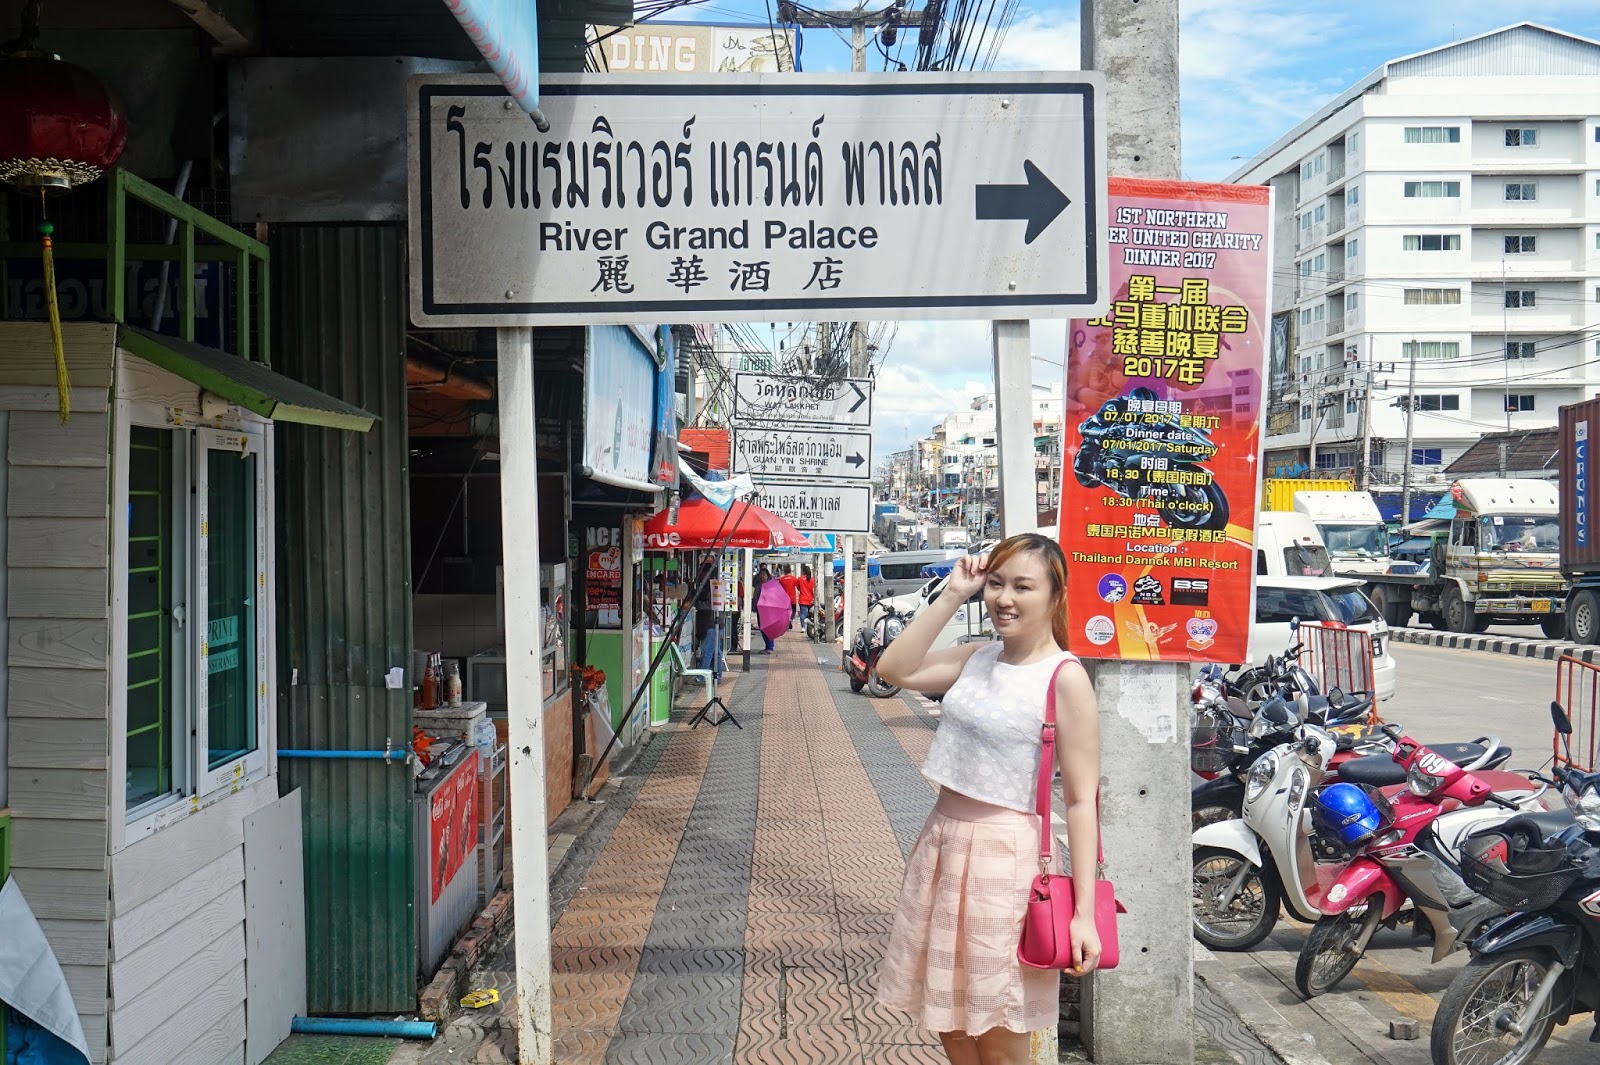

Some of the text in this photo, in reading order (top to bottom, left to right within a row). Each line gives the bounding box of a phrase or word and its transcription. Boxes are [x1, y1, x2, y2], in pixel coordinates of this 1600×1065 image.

[446, 107, 943, 210] โรงแรมริเวอร์ แกรนด์ พาเลส
[1116, 206, 1228, 229] 1ST NORTHERN
[539, 219, 878, 251] River Grand Palace
[1132, 228, 1189, 248] UNITED
[1192, 232, 1263, 251] CHARITY
[1124, 248, 1217, 269] DINNER 2017
[591, 256, 844, 294] 麗華酒店
[1128, 275, 1209, 306] 第一届
[1112, 327, 1219, 359] 慈善晚宴
[1124, 357, 1204, 385] 2017年
[1103, 411, 1220, 429] 07/01/2017 星期六
[1126, 428, 1196, 442] Dinner date:
[1102, 438, 1219, 457] 07/01/2017 Saturday
[753, 455, 828, 467] GUAN YIN SHRINE
[1141, 486, 1169, 497] Time
[1102, 497, 1214, 513] 18:30 (Thai o'clock)
[643, 532, 681, 547] true
[1086, 523, 1227, 543] 泰国丹诺MBI度假酒店
[1126, 542, 1177, 554] Location
[1072, 552, 1238, 570] Thailand Dannok MBI Resort
[586, 570, 620, 578] IMCARD
[1173, 579, 1208, 590] BS
[208, 654, 237, 670] NSURANCE
